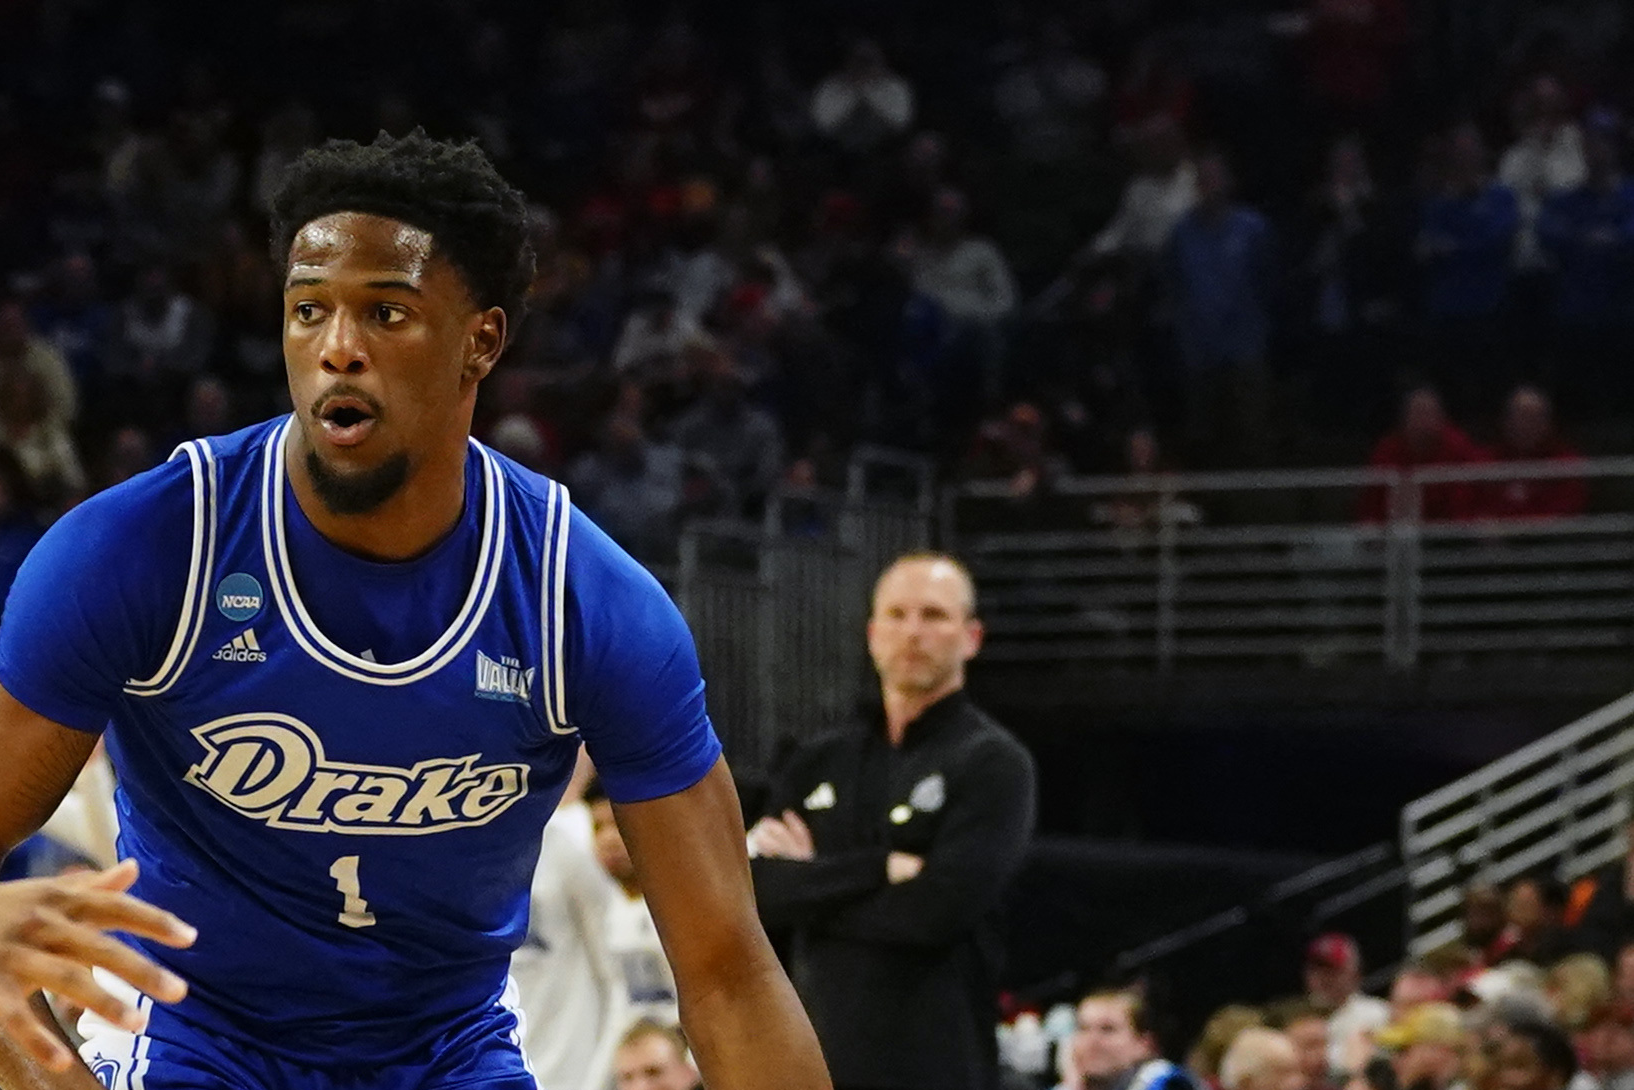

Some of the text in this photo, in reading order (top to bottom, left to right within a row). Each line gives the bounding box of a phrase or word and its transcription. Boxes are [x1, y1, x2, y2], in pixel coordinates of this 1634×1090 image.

[221, 594, 261, 609] NCAA
[212, 647, 267, 662] adidas
[182, 711, 531, 835] Drake
[329, 855, 377, 928] 1
